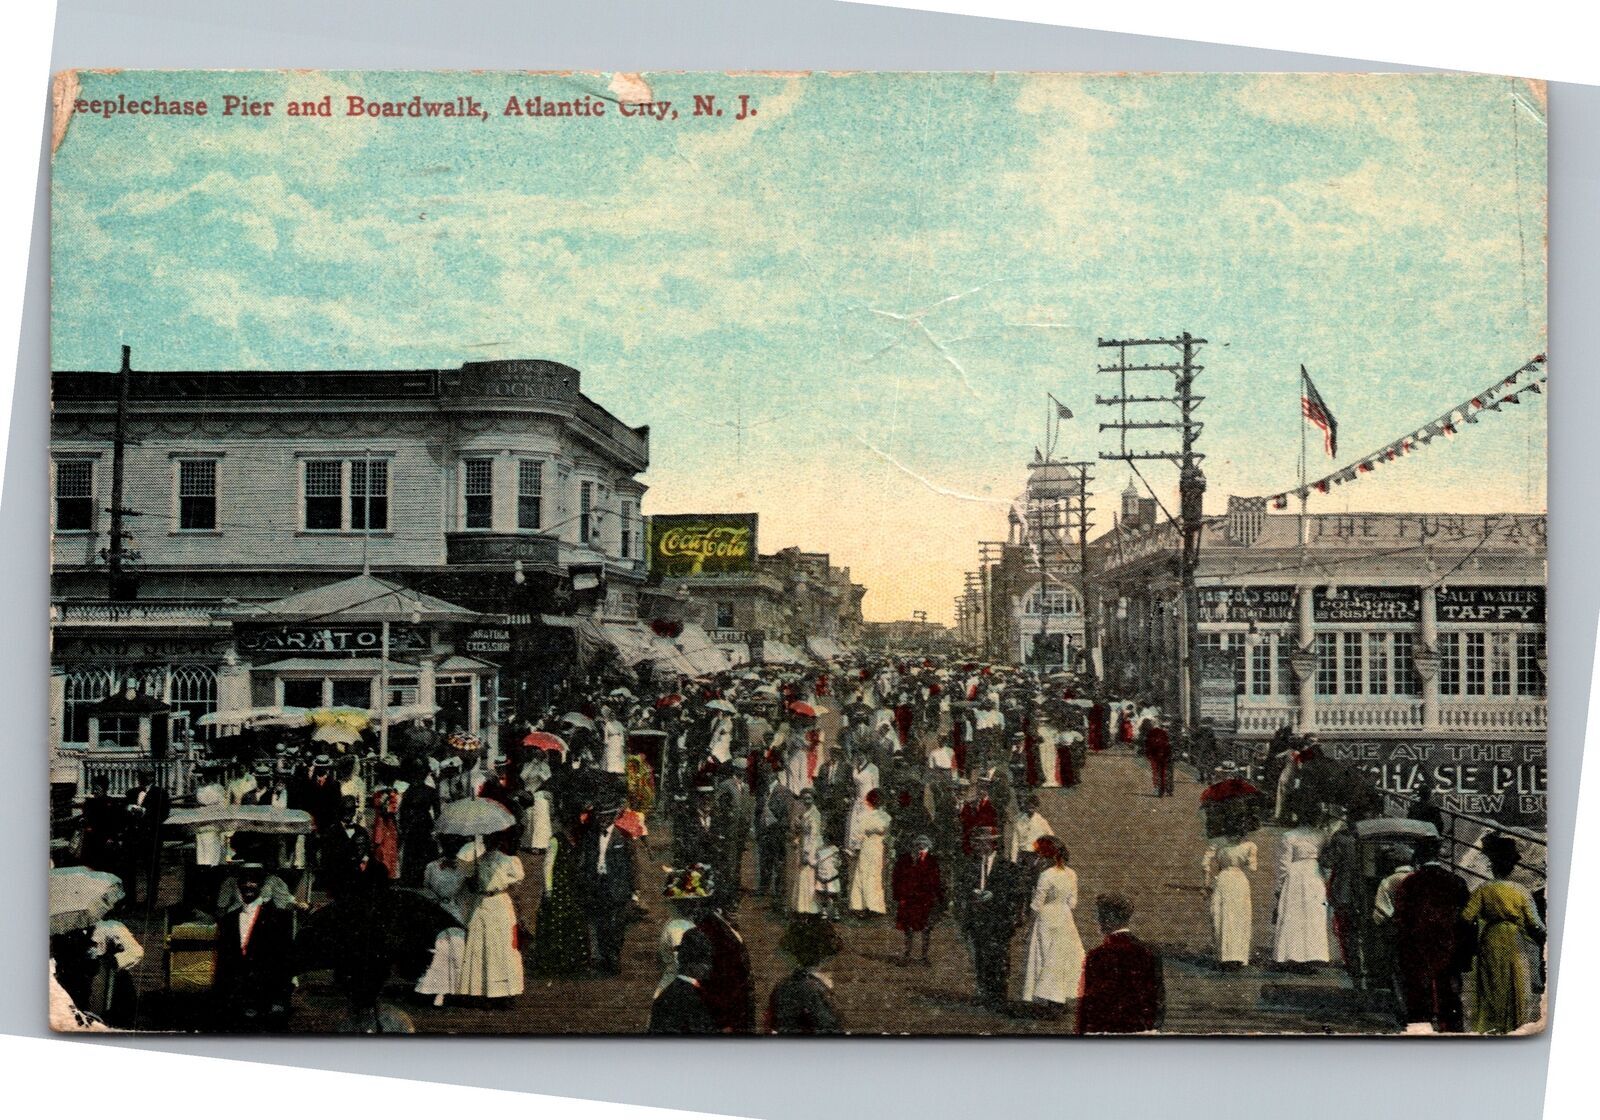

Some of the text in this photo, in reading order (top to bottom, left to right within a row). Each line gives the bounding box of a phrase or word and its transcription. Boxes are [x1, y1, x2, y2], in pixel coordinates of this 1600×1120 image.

[1314, 516, 1378, 538] THE
[1437, 591, 1538, 602] SALT WATER
[1442, 605, 1534, 619] TAFFY
[1334, 743, 1380, 760] ME
[1389, 743, 1435, 761] AT
[1444, 744, 1513, 762] THE
[1443, 794, 1505, 813] NEW
